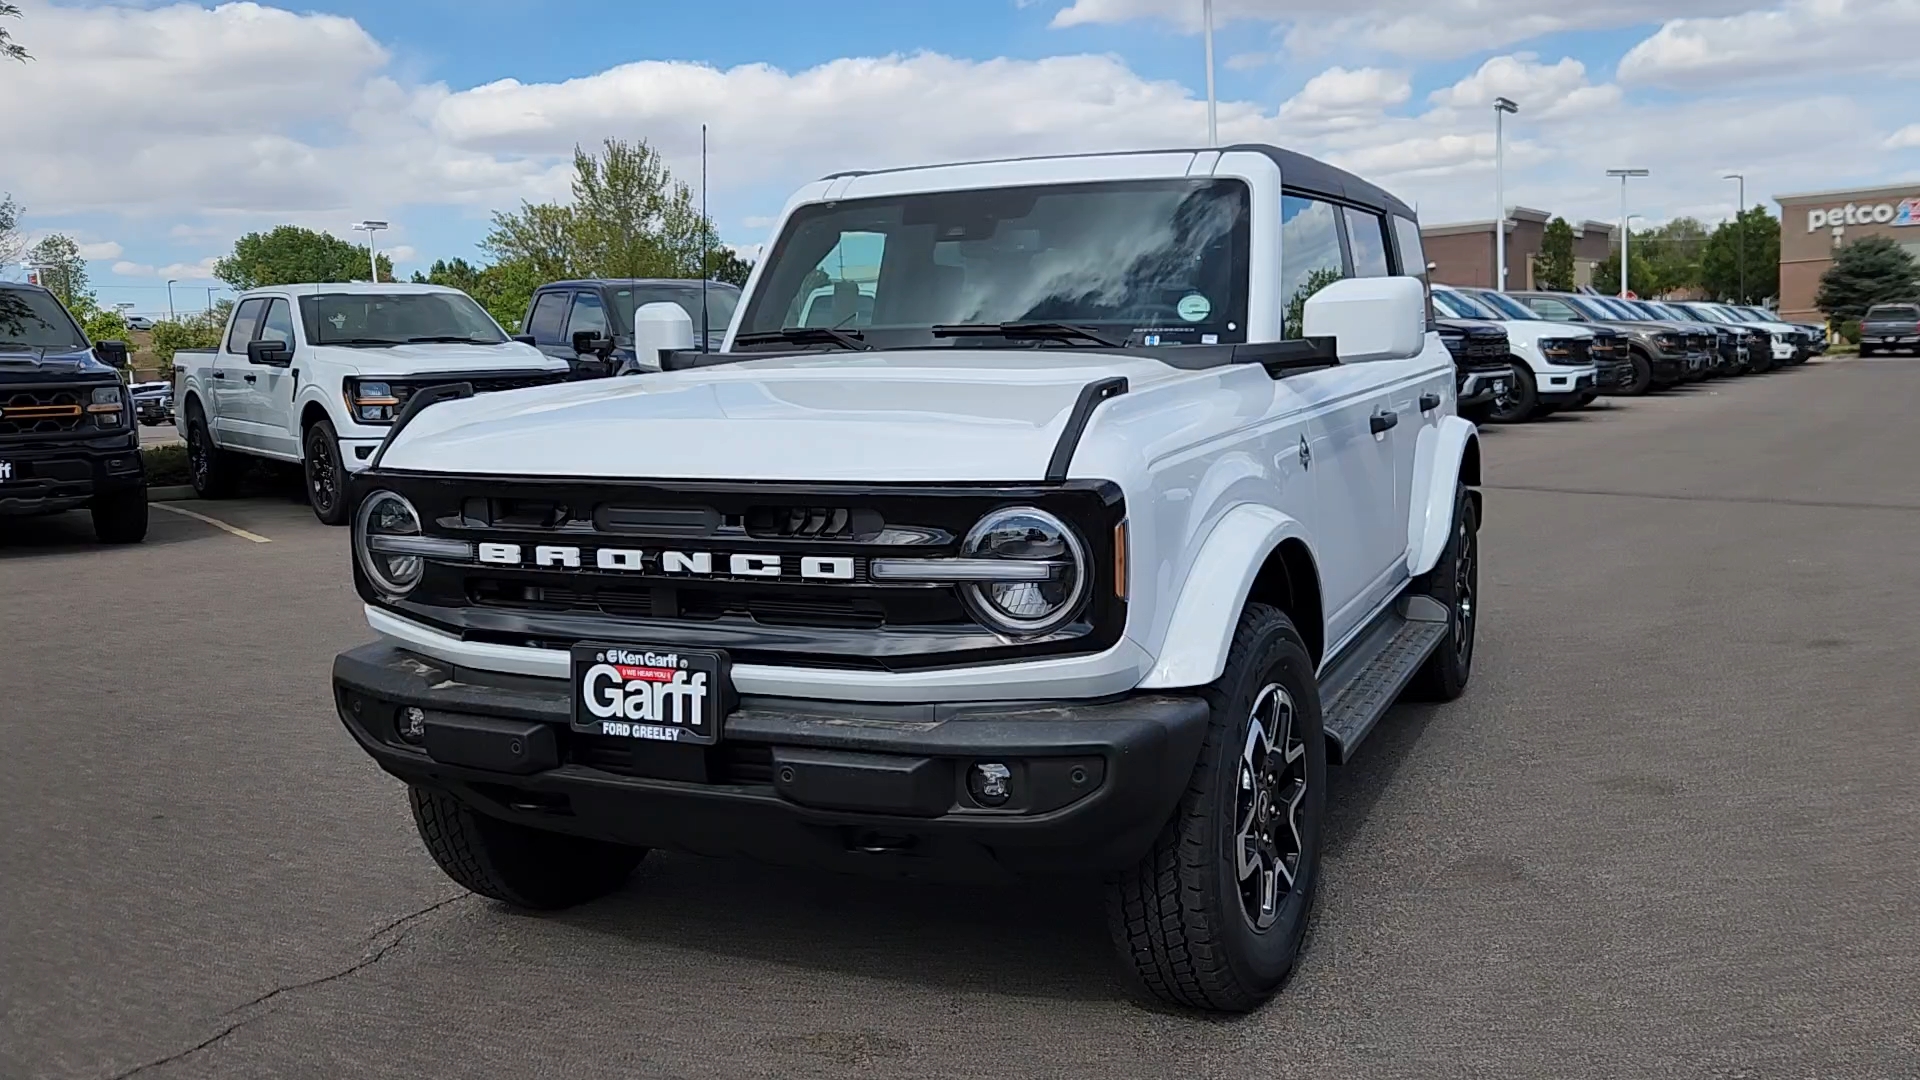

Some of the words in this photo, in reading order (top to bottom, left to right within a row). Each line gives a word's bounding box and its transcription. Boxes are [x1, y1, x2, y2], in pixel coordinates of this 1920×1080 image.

[1808, 202, 1894, 233] petco
[478, 542, 855, 580] BRONCO
[617, 650, 645, 666] Ken
[644, 652, 678, 668] Garff
[637, 669, 654, 677] HEAR
[583, 663, 707, 725] Garff
[602, 721, 630, 737] FORD
[632, 724, 680, 741] GREELEY
